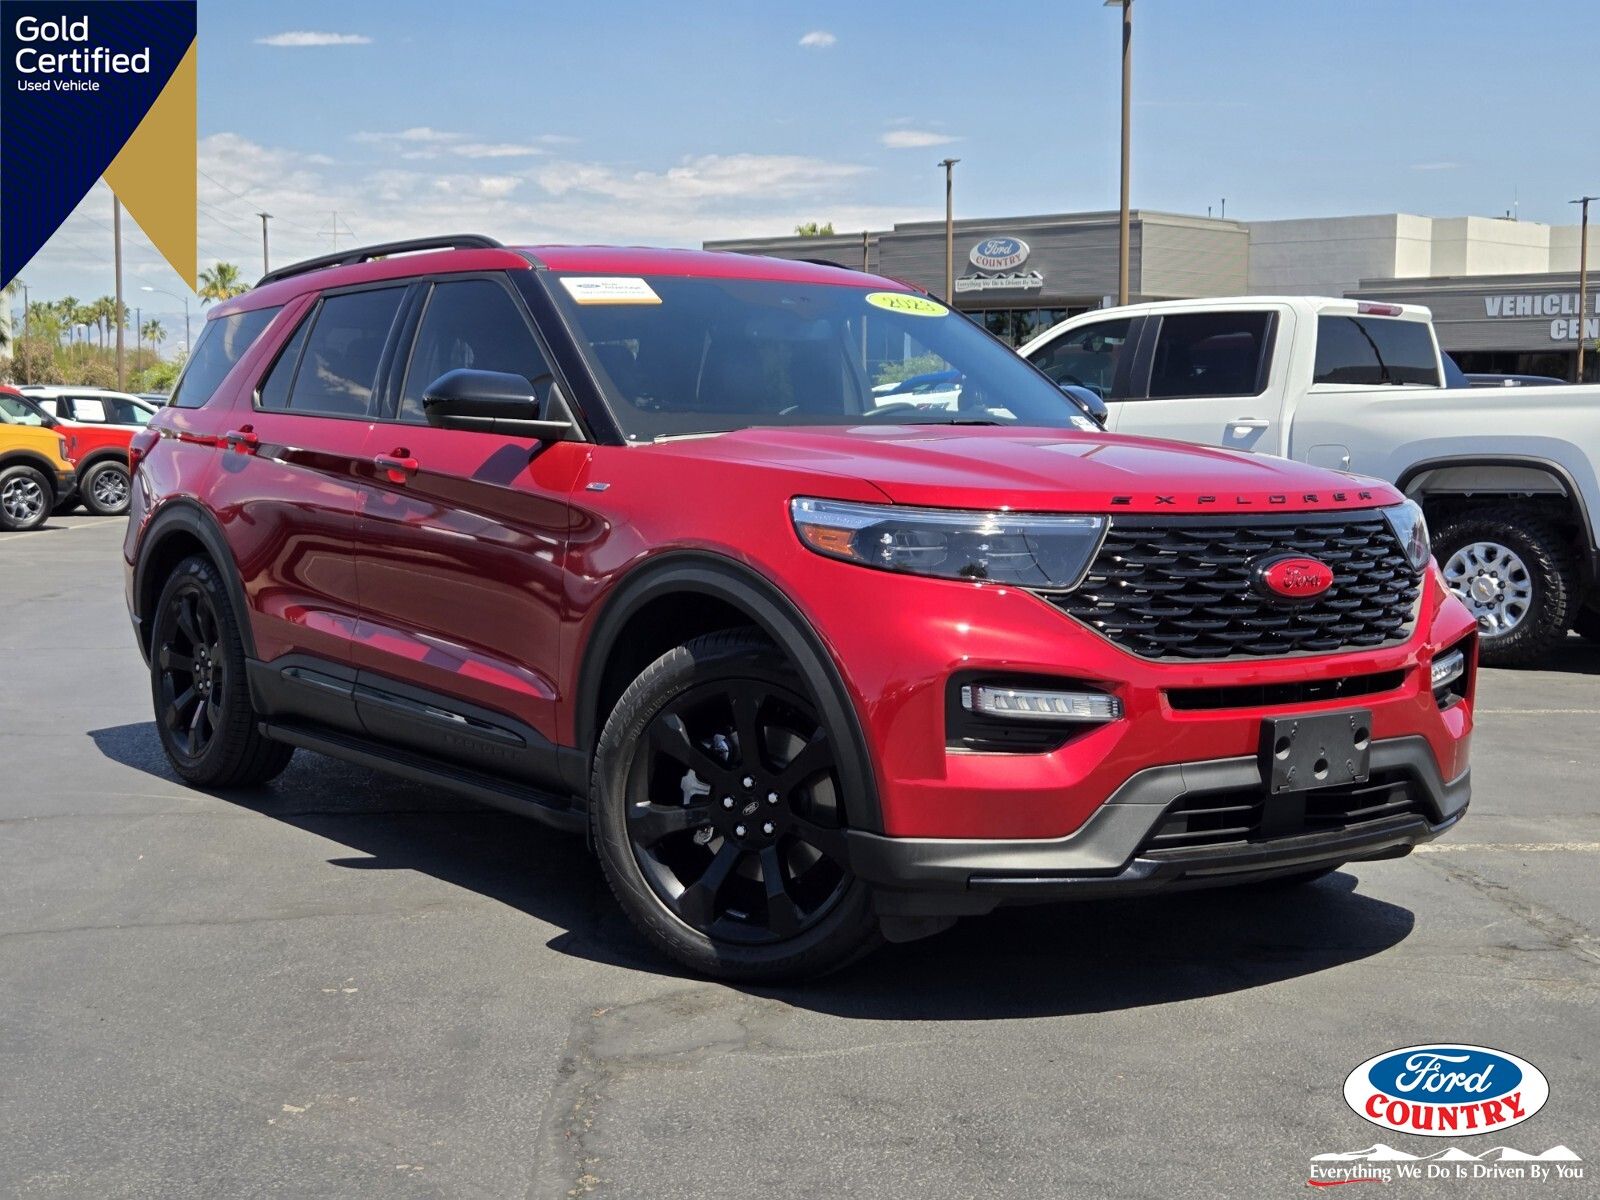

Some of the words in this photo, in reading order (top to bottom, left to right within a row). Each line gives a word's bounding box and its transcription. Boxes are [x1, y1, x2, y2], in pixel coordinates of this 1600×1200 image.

[984, 240, 1012, 255] Ford
[976, 254, 1021, 267] COUNTRY
[1111, 490, 1373, 505] EXPLORER
[1282, 564, 1321, 588] Ford
